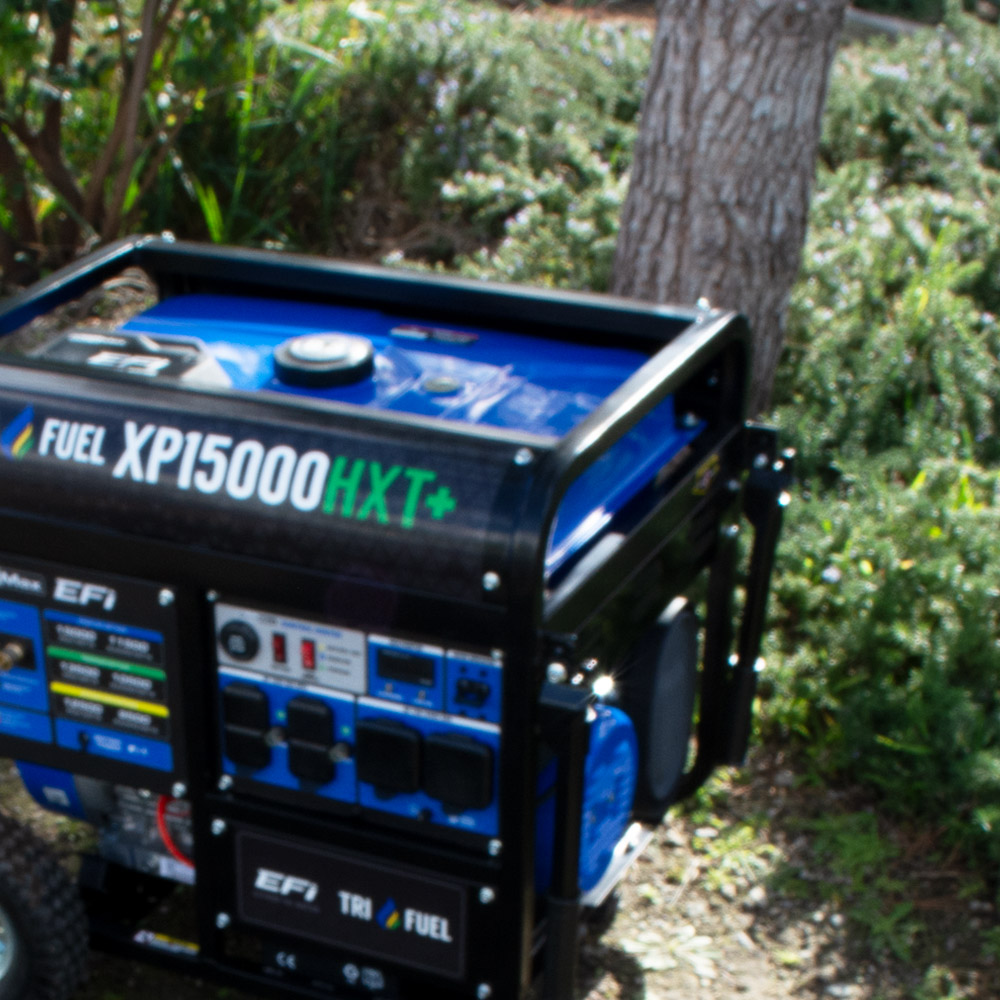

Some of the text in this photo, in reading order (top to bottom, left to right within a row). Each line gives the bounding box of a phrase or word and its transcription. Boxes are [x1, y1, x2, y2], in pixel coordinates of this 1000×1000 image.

[37, 417, 106, 466] FUEL
[337, 890, 373, 921] TRI
[403, 907, 453, 943] FUEL
